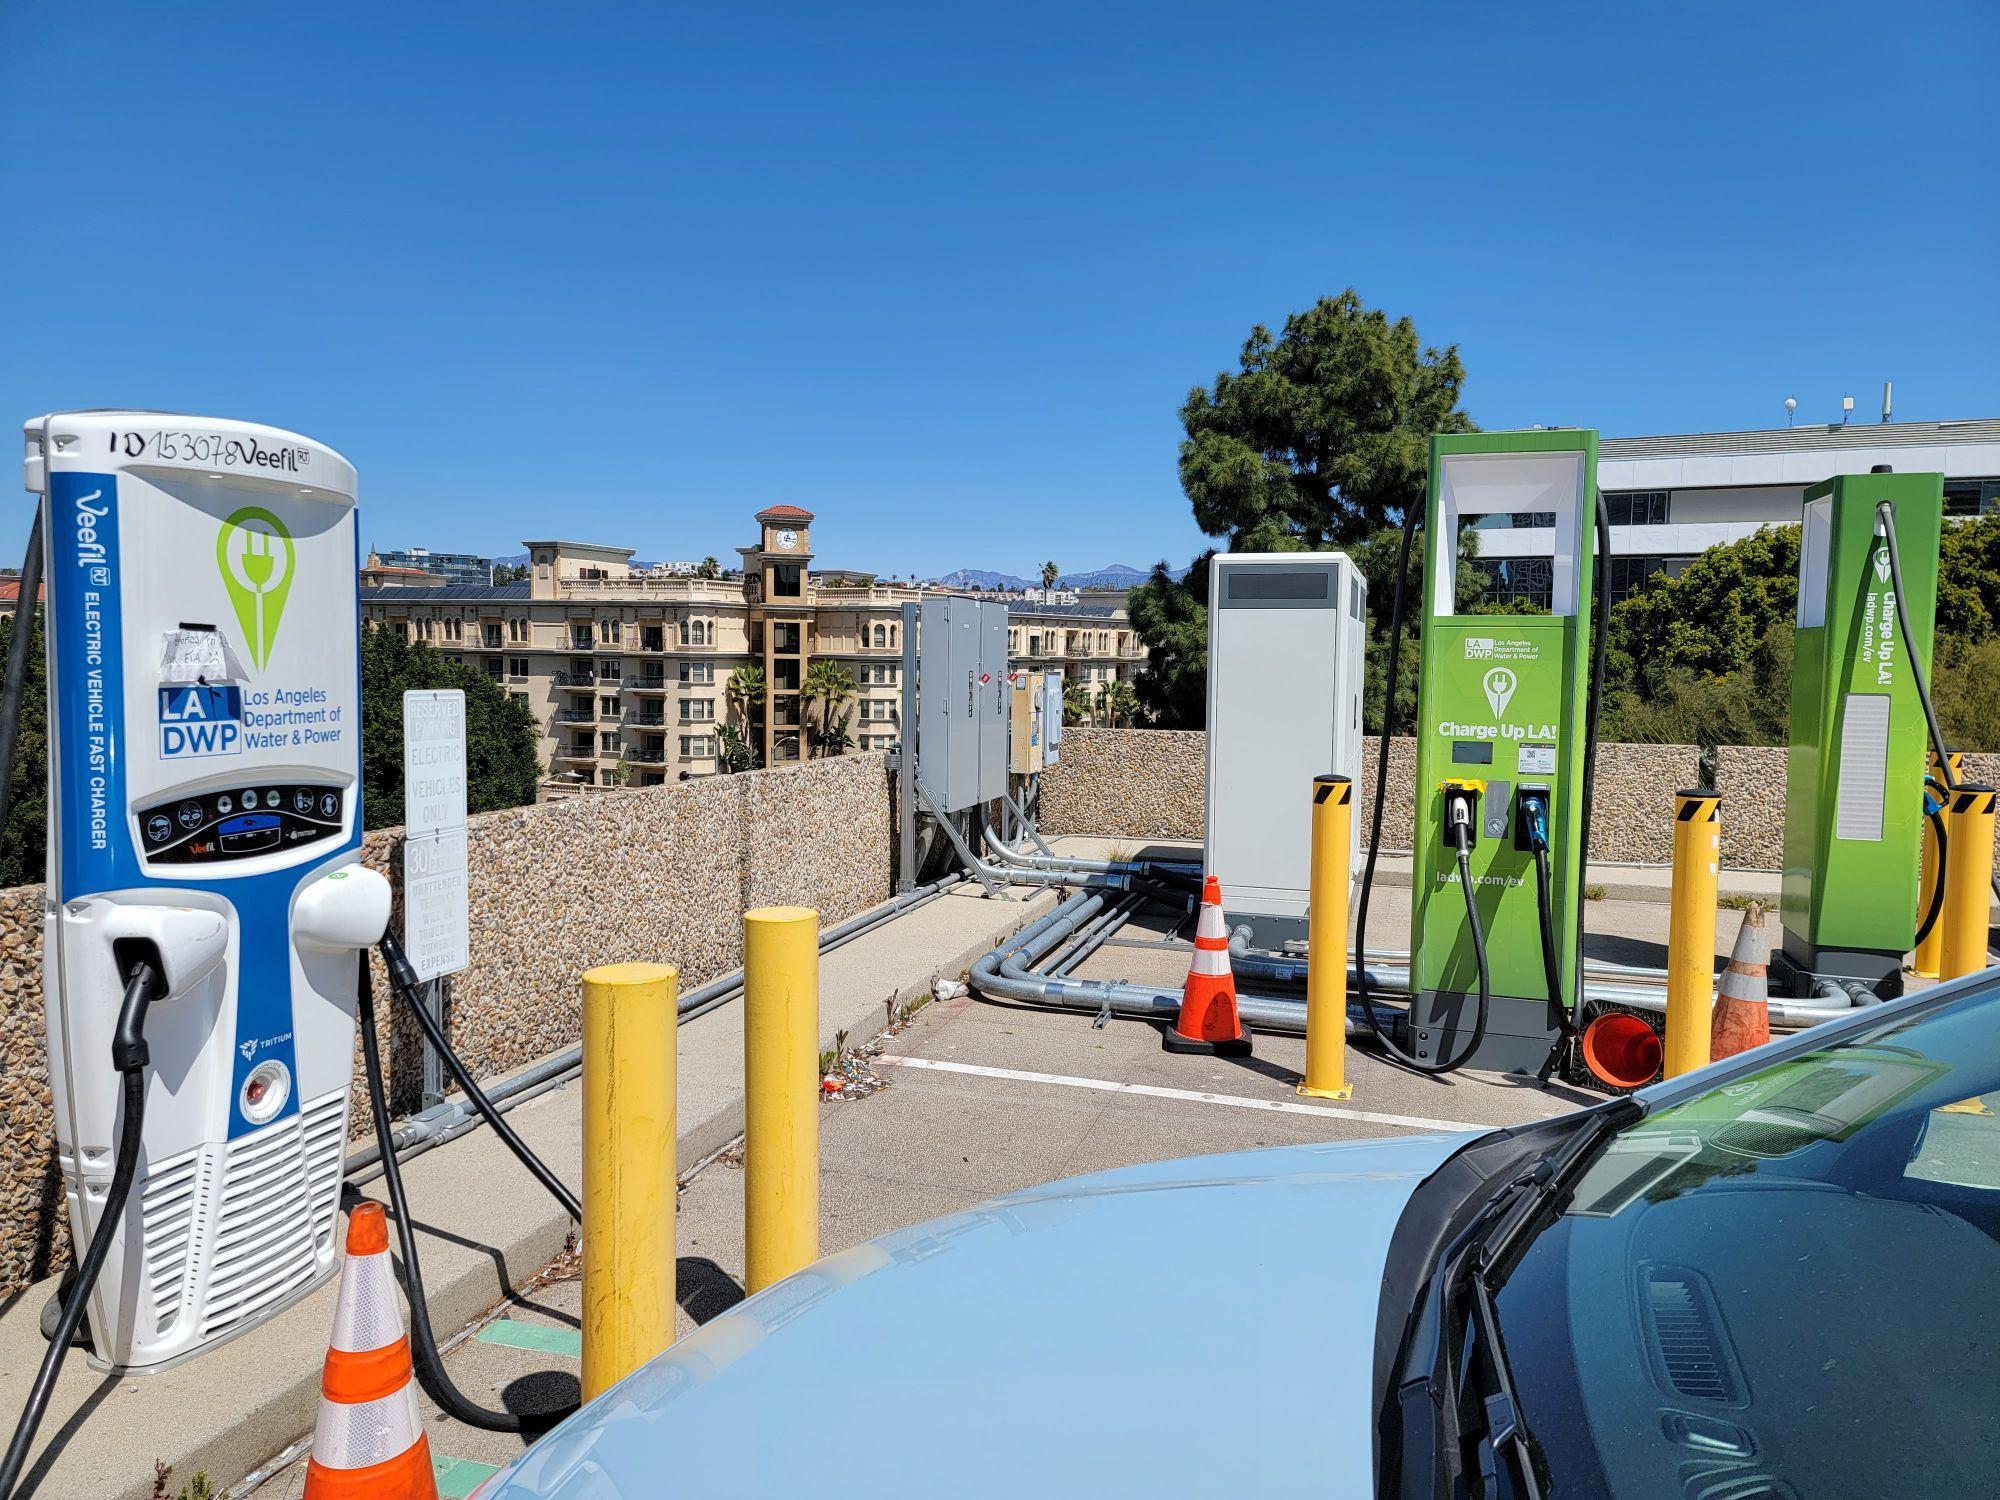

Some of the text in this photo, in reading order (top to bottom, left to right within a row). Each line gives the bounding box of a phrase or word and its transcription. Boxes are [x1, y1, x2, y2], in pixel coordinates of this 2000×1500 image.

[234, 437, 299, 472] Veefil
[75, 489, 110, 586] Veefil RT
[1862, 592, 1878, 663] ladwp.com/ev
[1877, 591, 1897, 685] Charge Up LA!
[1466, 639, 1480, 648] LA
[1466, 649, 1492, 659] DWP
[1506, 639, 1531, 647] Angeles
[162, 691, 207, 720] LA
[243, 687, 327, 707] Los Angeles
[85, 592, 107, 850] ELECTRIC VEHICLE FAST CHARGER
[244, 706, 342, 730] Department of
[410, 701, 459, 719] RESERVED
[163, 724, 238, 755] DWP
[245, 728, 342, 749] Water & Power
[1438, 721, 1557, 740] Charge Up LA!
[412, 744, 460, 766] ELECTRIC
[411, 776, 461, 799] VEHICLES
[422, 803, 449, 824] ONLY
[410, 845, 428, 875] 30
[260, 1032, 292, 1049] TRITIUM
